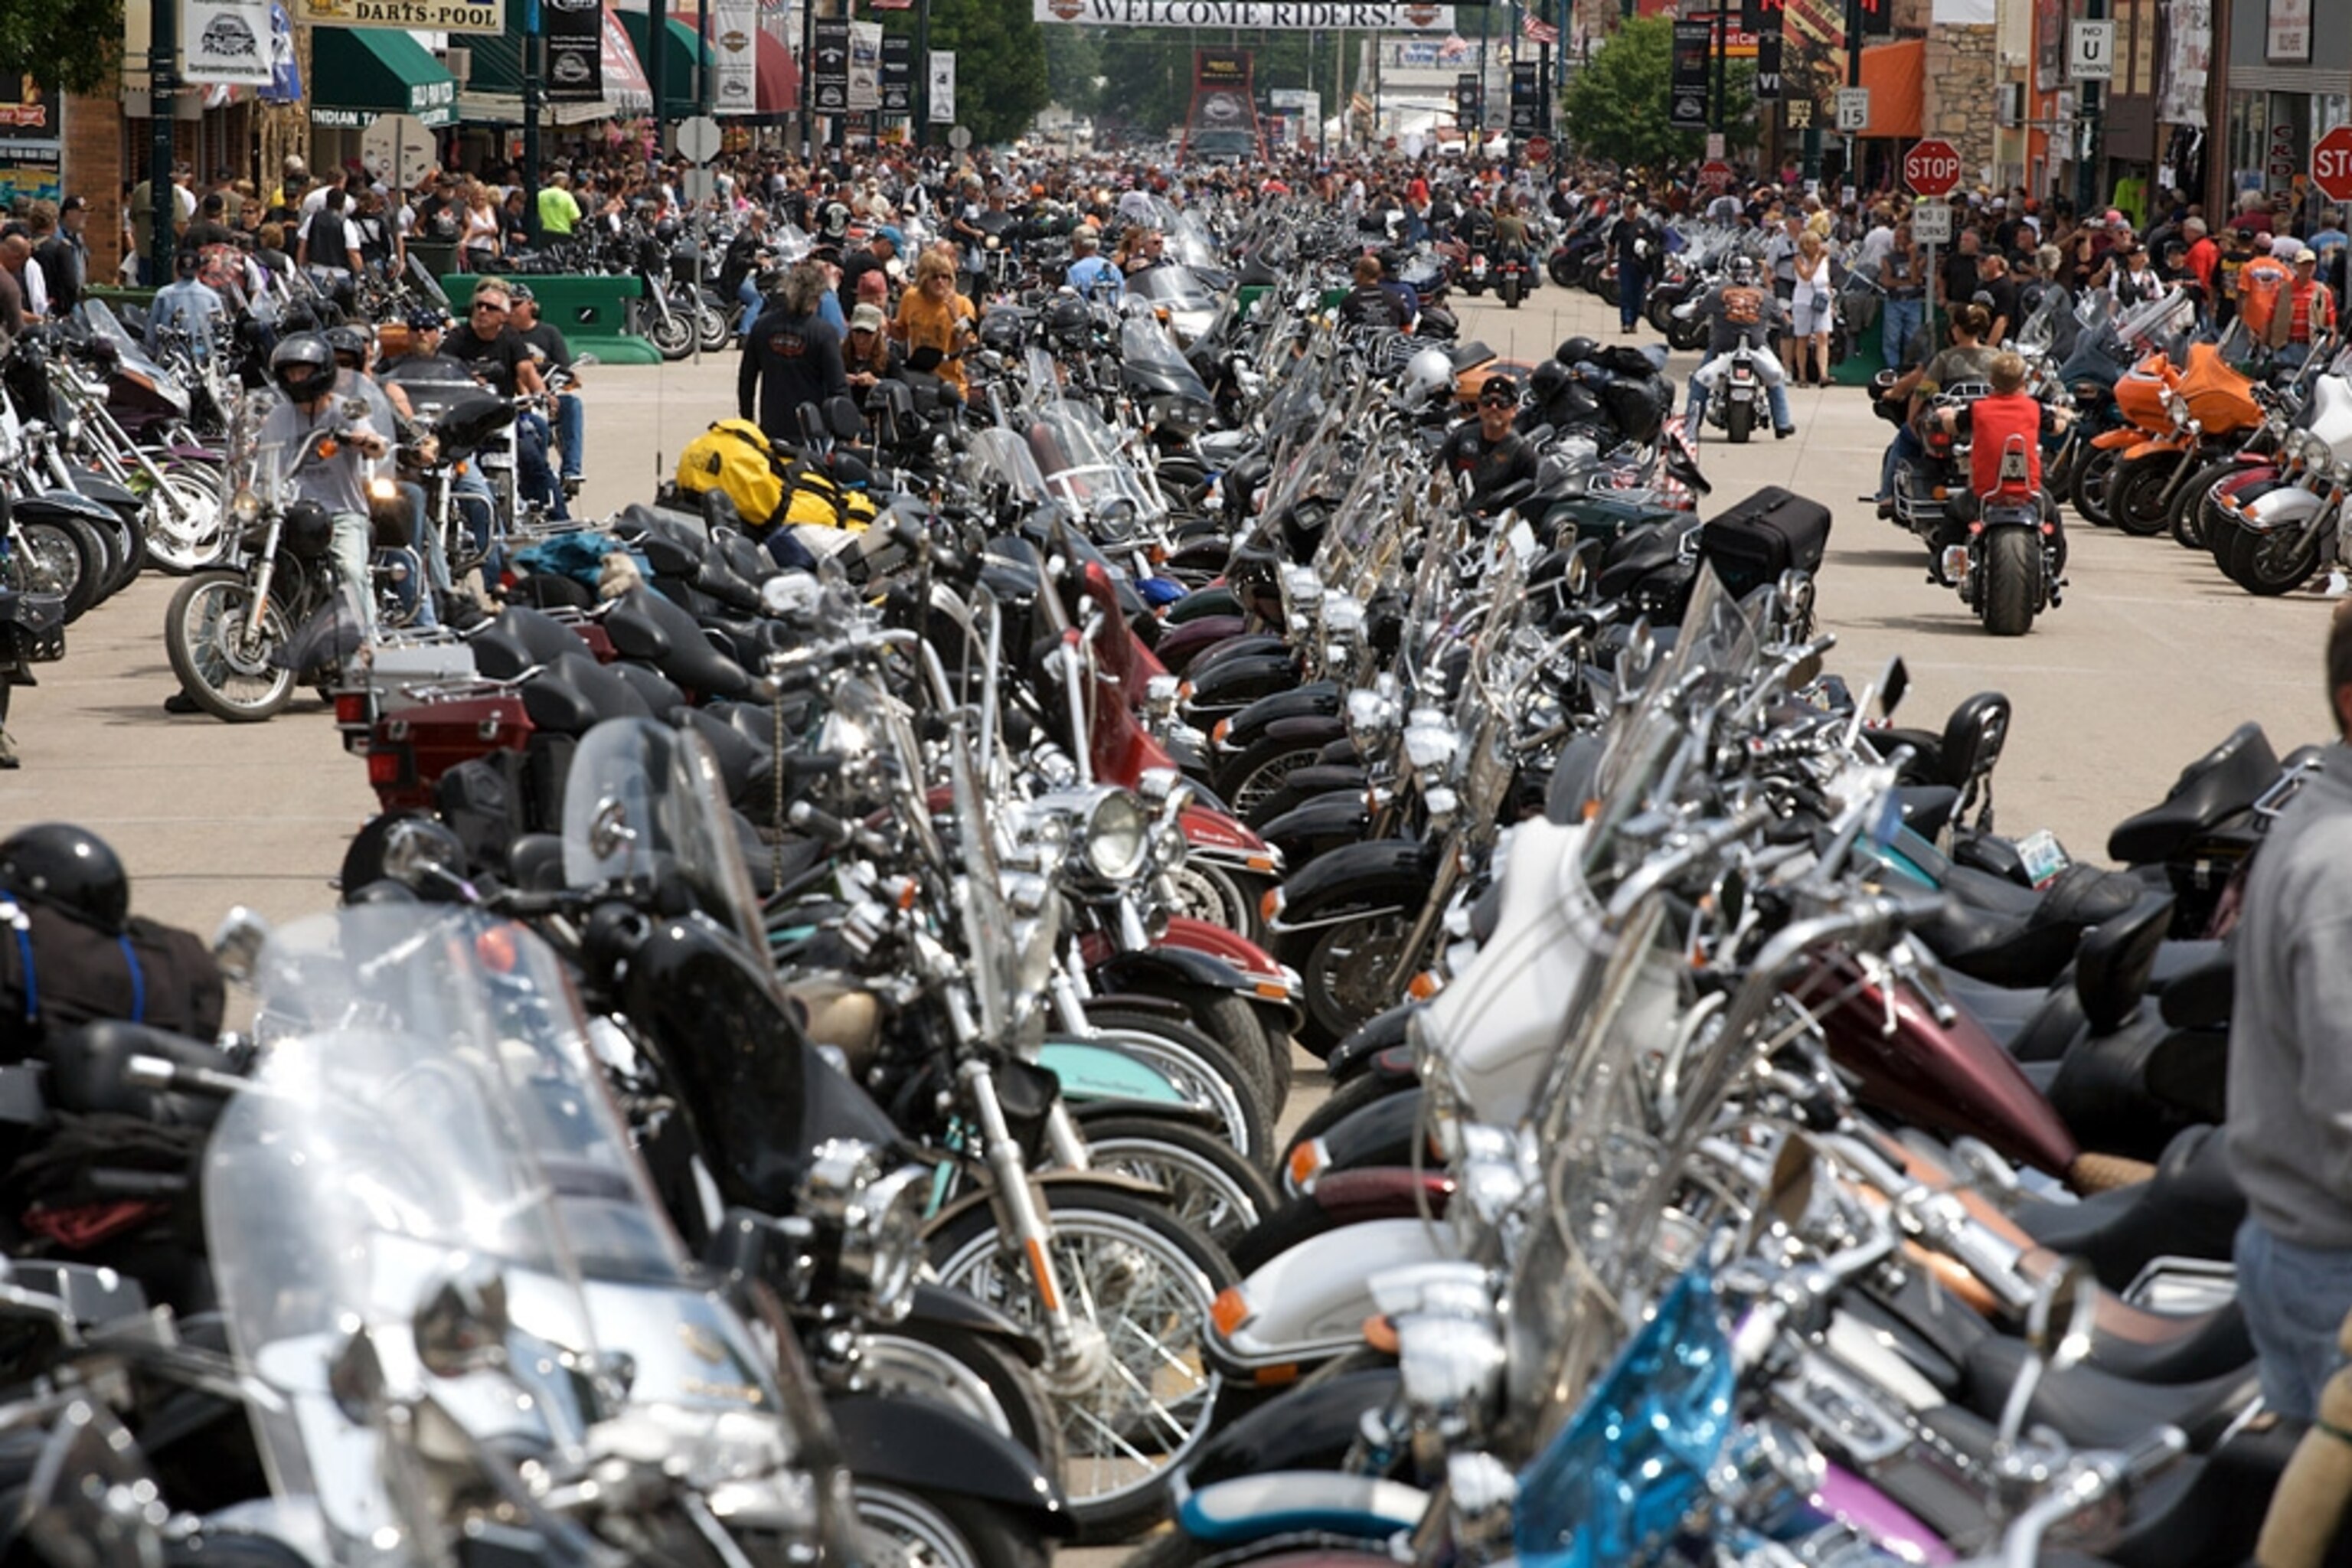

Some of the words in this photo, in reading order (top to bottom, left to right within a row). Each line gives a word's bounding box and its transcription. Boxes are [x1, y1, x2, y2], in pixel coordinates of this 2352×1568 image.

[1093, 0, 1261, 25] WELCOME
[1272, 3, 1396, 27] RIDERS!
[2082, 27, 2102, 36] NO
[2084, 41, 2099, 60] U
[2073, 64, 2111, 73] TURNS
[312, 109, 358, 126] INDIAN
[1844, 109, 1864, 125] 15
[1908, 157, 1958, 179] STOP
[2318, 150, 2352, 177] ST
[1918, 209, 1932, 221] NO
[1937, 211, 1944, 221] U
[1916, 225, 1947, 237] TURNS
